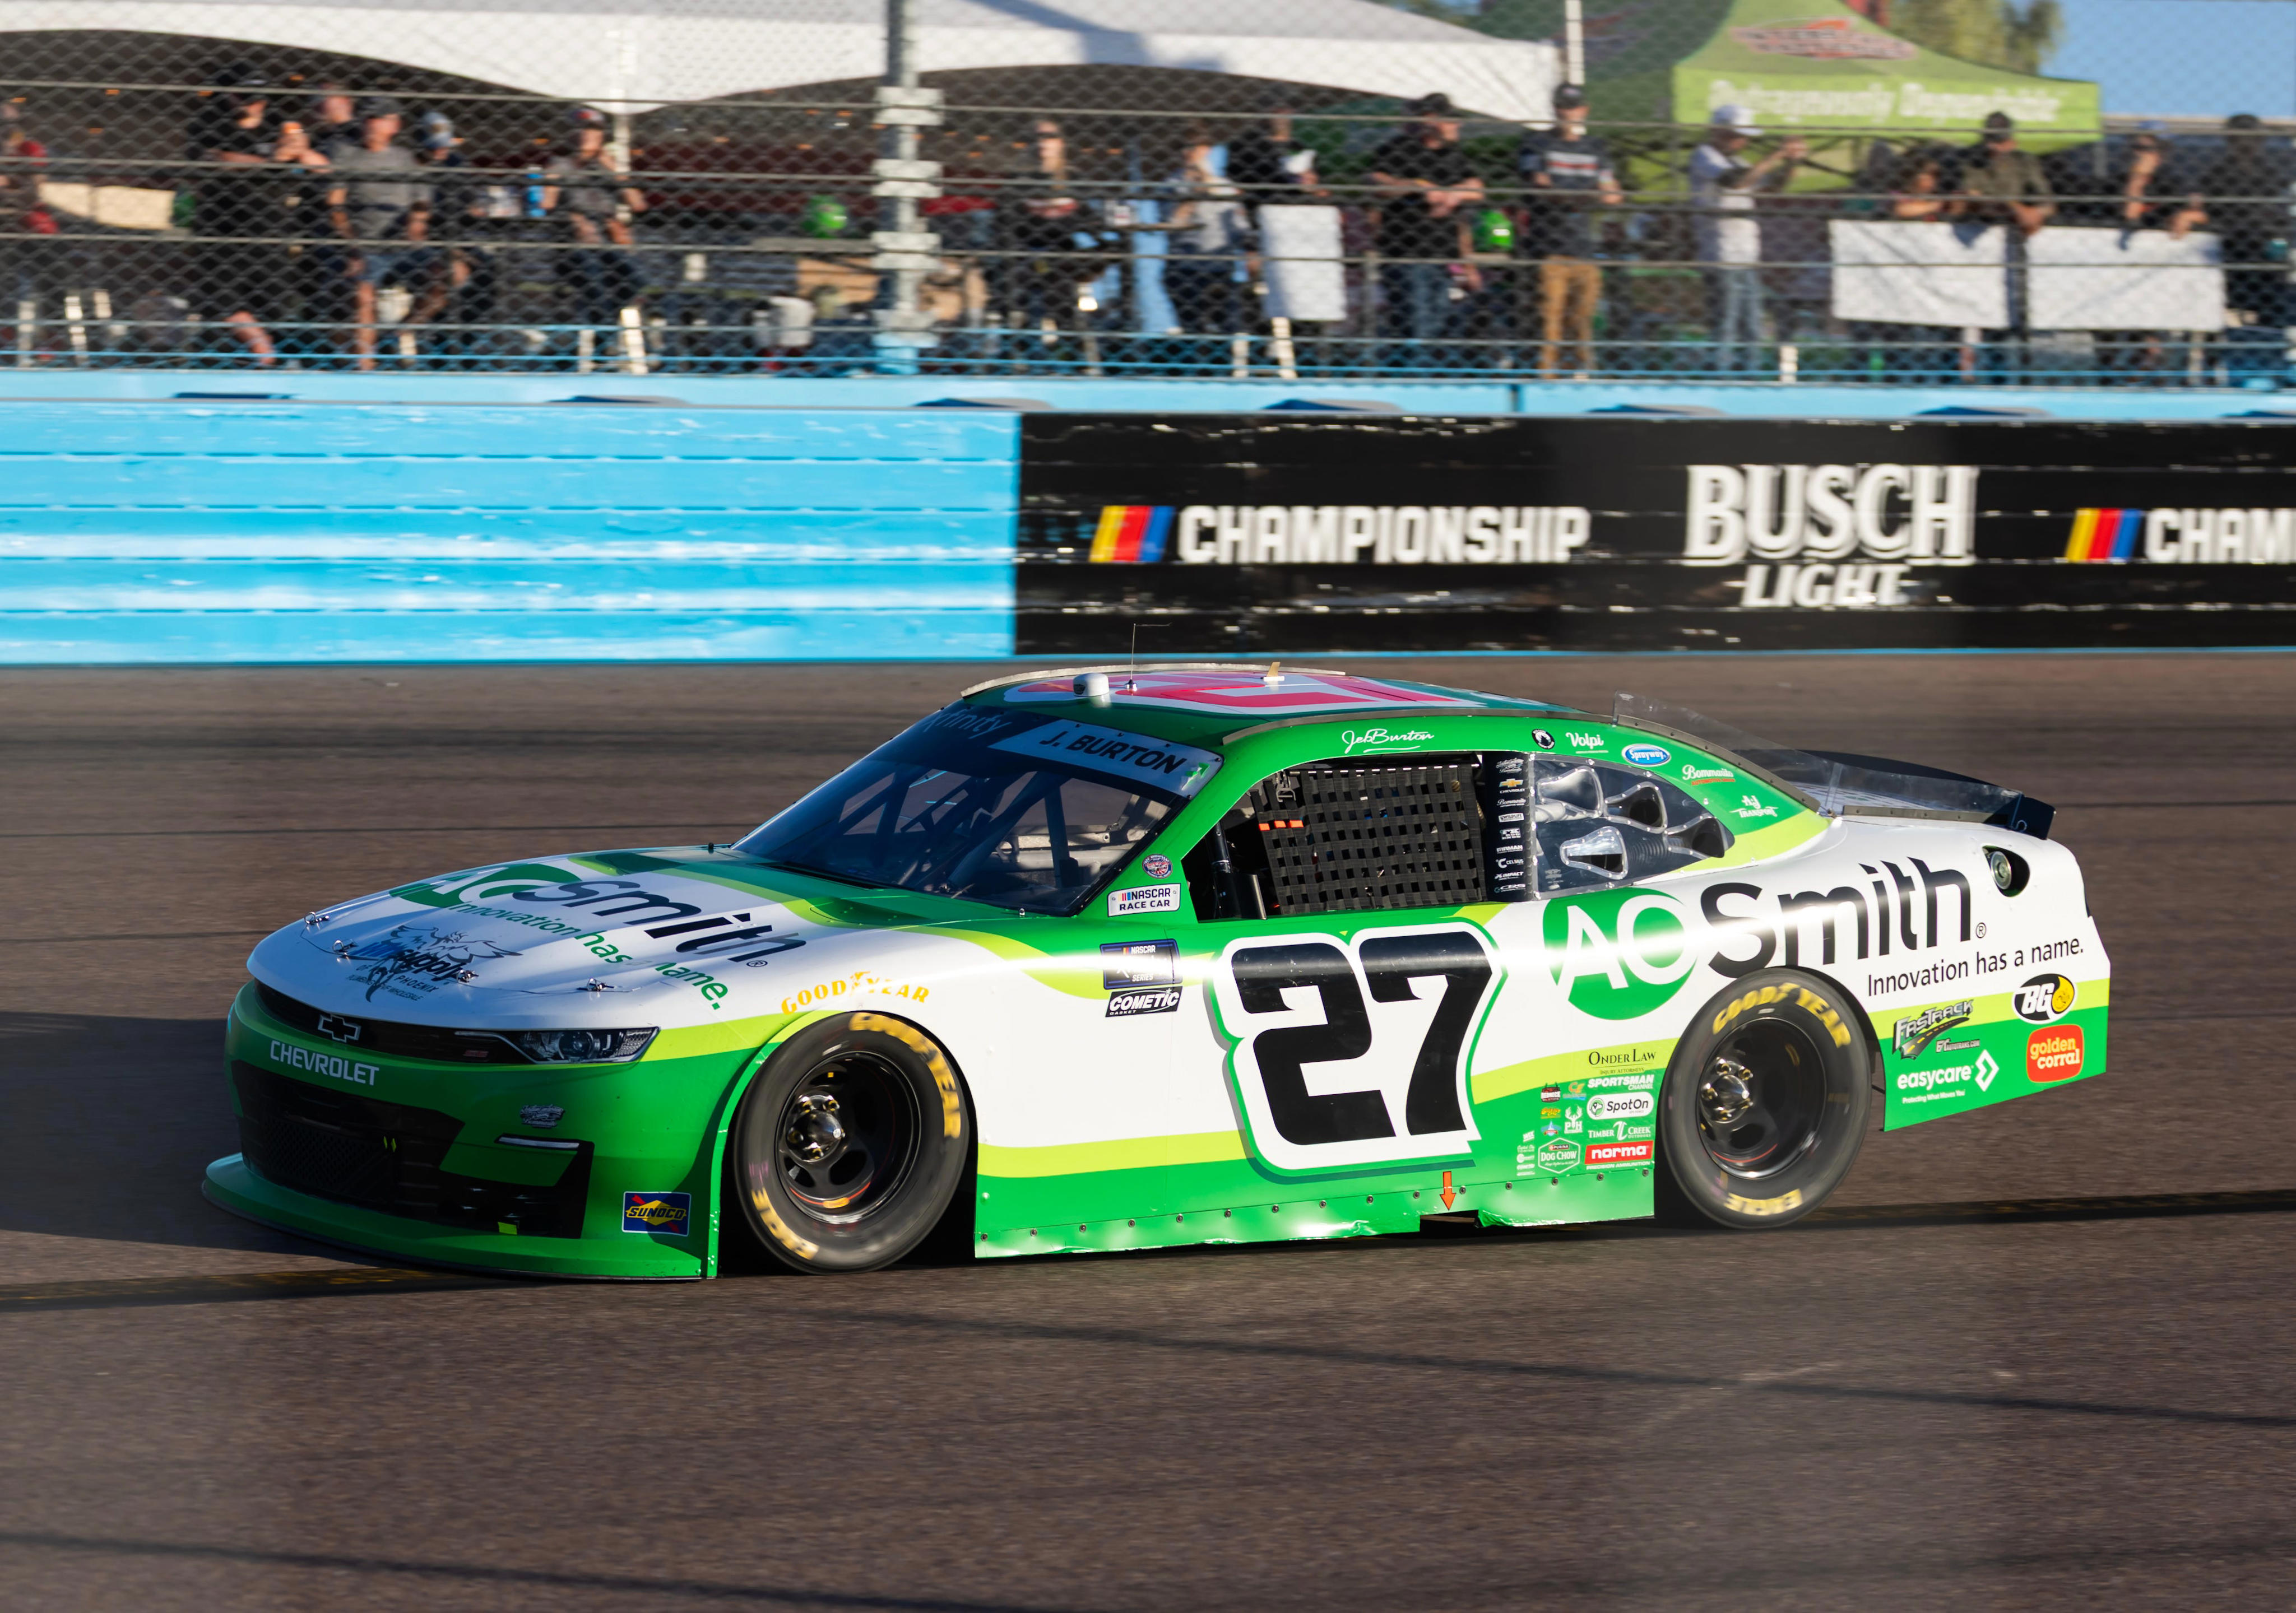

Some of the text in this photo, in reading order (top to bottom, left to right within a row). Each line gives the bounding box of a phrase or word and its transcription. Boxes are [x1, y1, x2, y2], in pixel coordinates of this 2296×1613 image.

[1683, 464, 1978, 566] BUSCH
[1179, 506, 1589, 563] CHAMPIONSHIP
[1741, 563, 1910, 607] LIGHT
[1565, 732, 1604, 749] Volpi
[1040, 731, 1187, 774] J. BURTON
[1629, 749, 1663, 761] Sprayway
[1682, 764, 1734, 780] Bommarito
[1131, 888, 1171, 901] NASCAR
[1120, 901, 1147, 911] RACE
[448, 901, 582, 936] Innovation
[574, 930, 633, 964] has
[1131, 945, 1156, 954] NASCAR
[1868, 938, 2084, 997] Innovation has a name.
[396, 975, 439, 993] PHOENIX
[1109, 991, 1180, 1011] COMETIC
[2017, 983, 2056, 1016] BG
[1232, 931, 1492, 1145] 27
[2030, 1037, 2076, 1061] golden
[270, 1040, 379, 1086] CHEVROLET
[2037, 1048, 2081, 1070] corral
[1588, 1074, 1654, 1088] SPORTSMAN
[1897, 1065, 1972, 1091] easycare
[1607, 1099, 1649, 1113] SpotOn
[1588, 1126, 1651, 1138] TIMBER CREEK
[1541, 1152, 1556, 1161] DOG
[1556, 1151, 1577, 1160] CHOW
[1591, 1145, 1646, 1159] norma
[628, 1207, 685, 1219] SUNOCO
